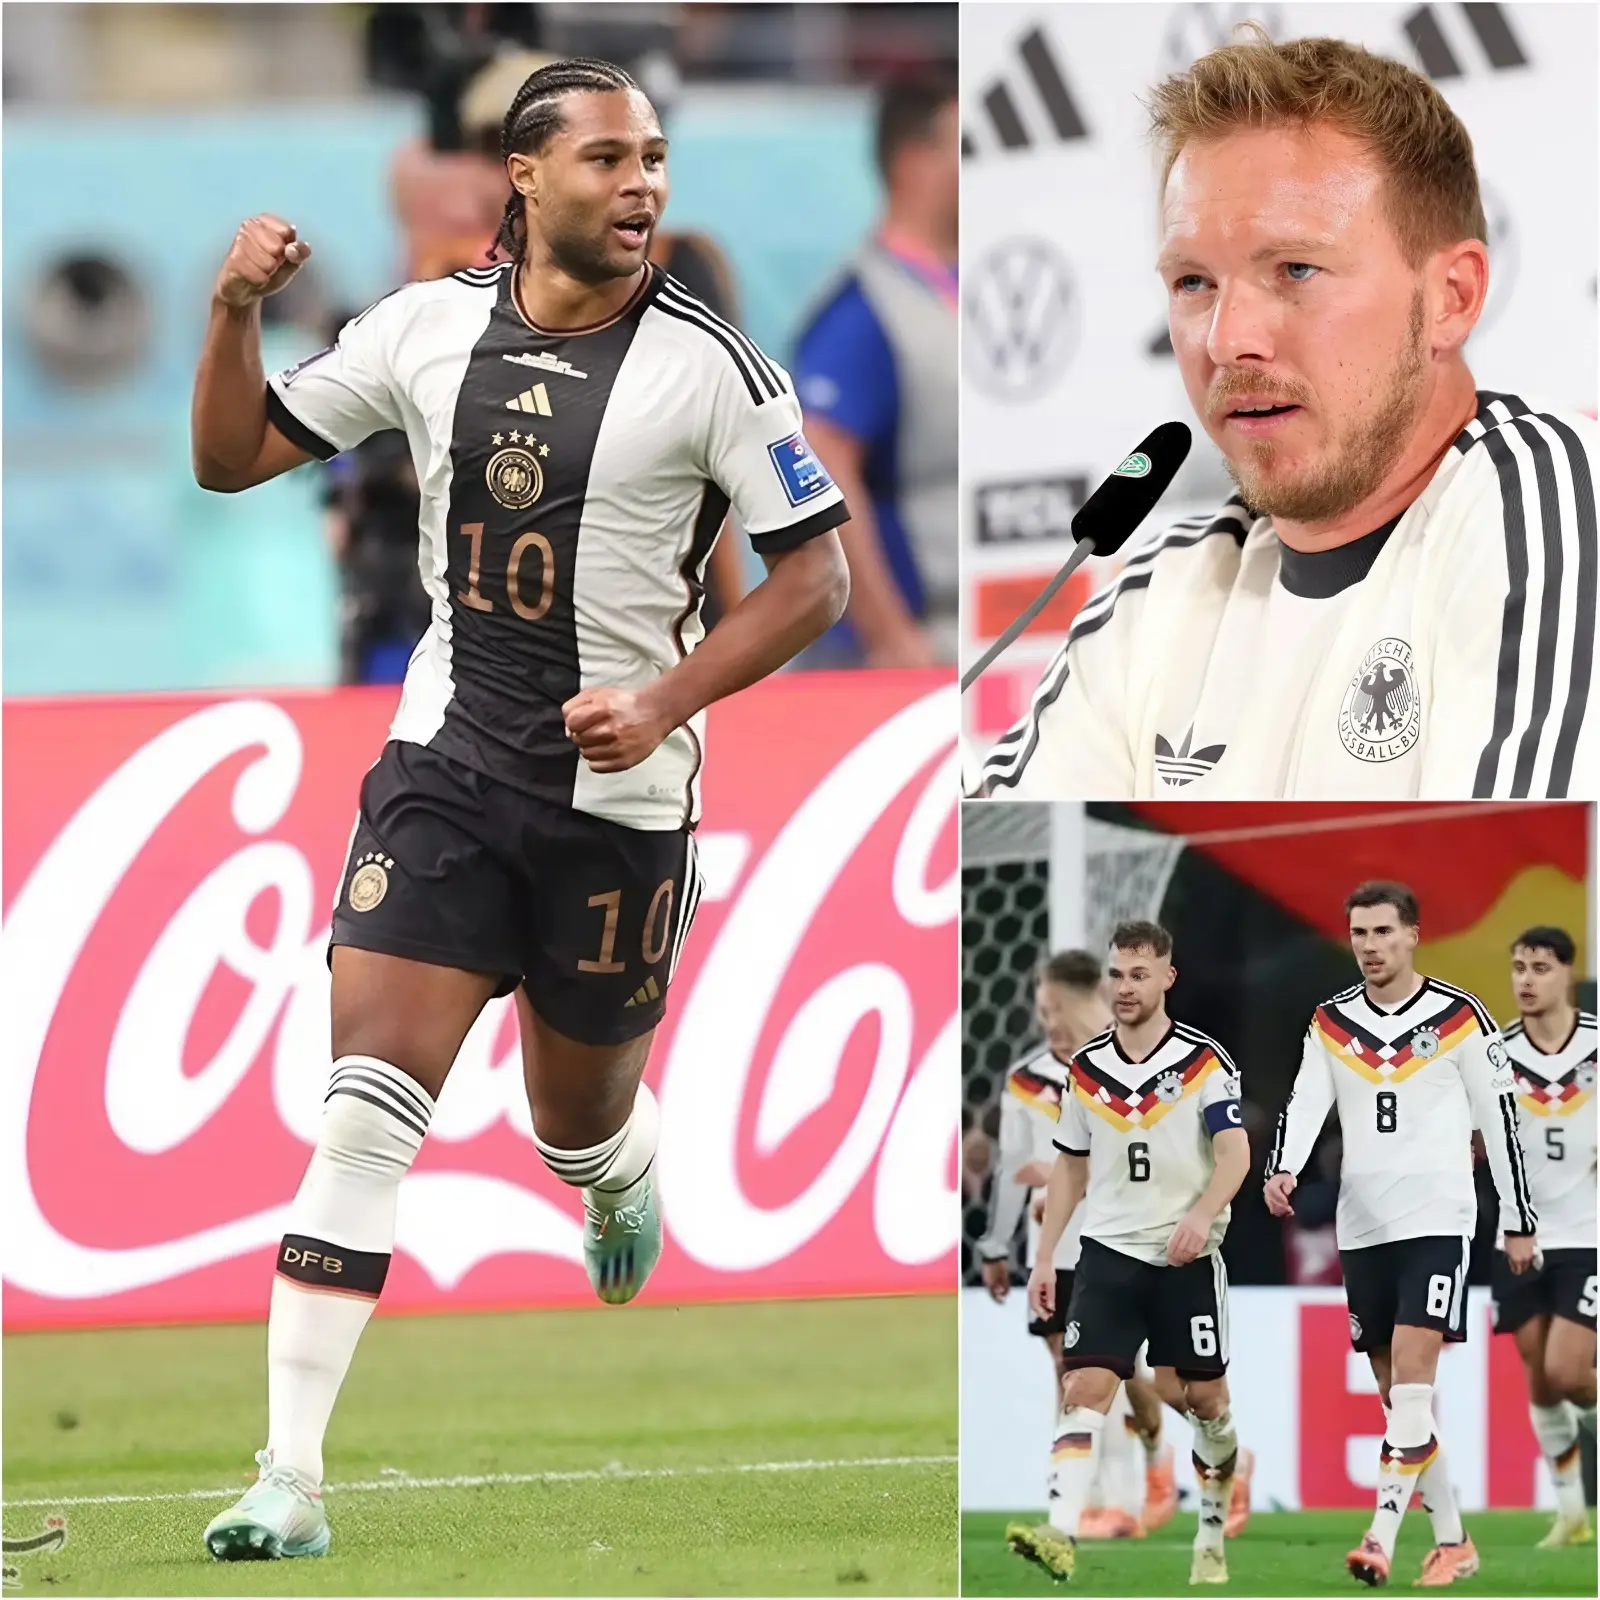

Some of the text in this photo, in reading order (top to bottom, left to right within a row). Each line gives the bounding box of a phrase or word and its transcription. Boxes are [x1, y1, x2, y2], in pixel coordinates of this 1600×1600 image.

[457, 522, 554, 620] 10
[578, 879, 674, 973] 10
[1226, 1103, 1242, 1124] C
[1376, 1091, 1397, 1133] 8
[1128, 1142, 1150, 1182] 6
[1545, 1127, 1564, 1161] 5
[284, 1247, 342, 1273] DFB
[1426, 1274, 1452, 1318] 8
[1190, 1315, 1217, 1357] 6
